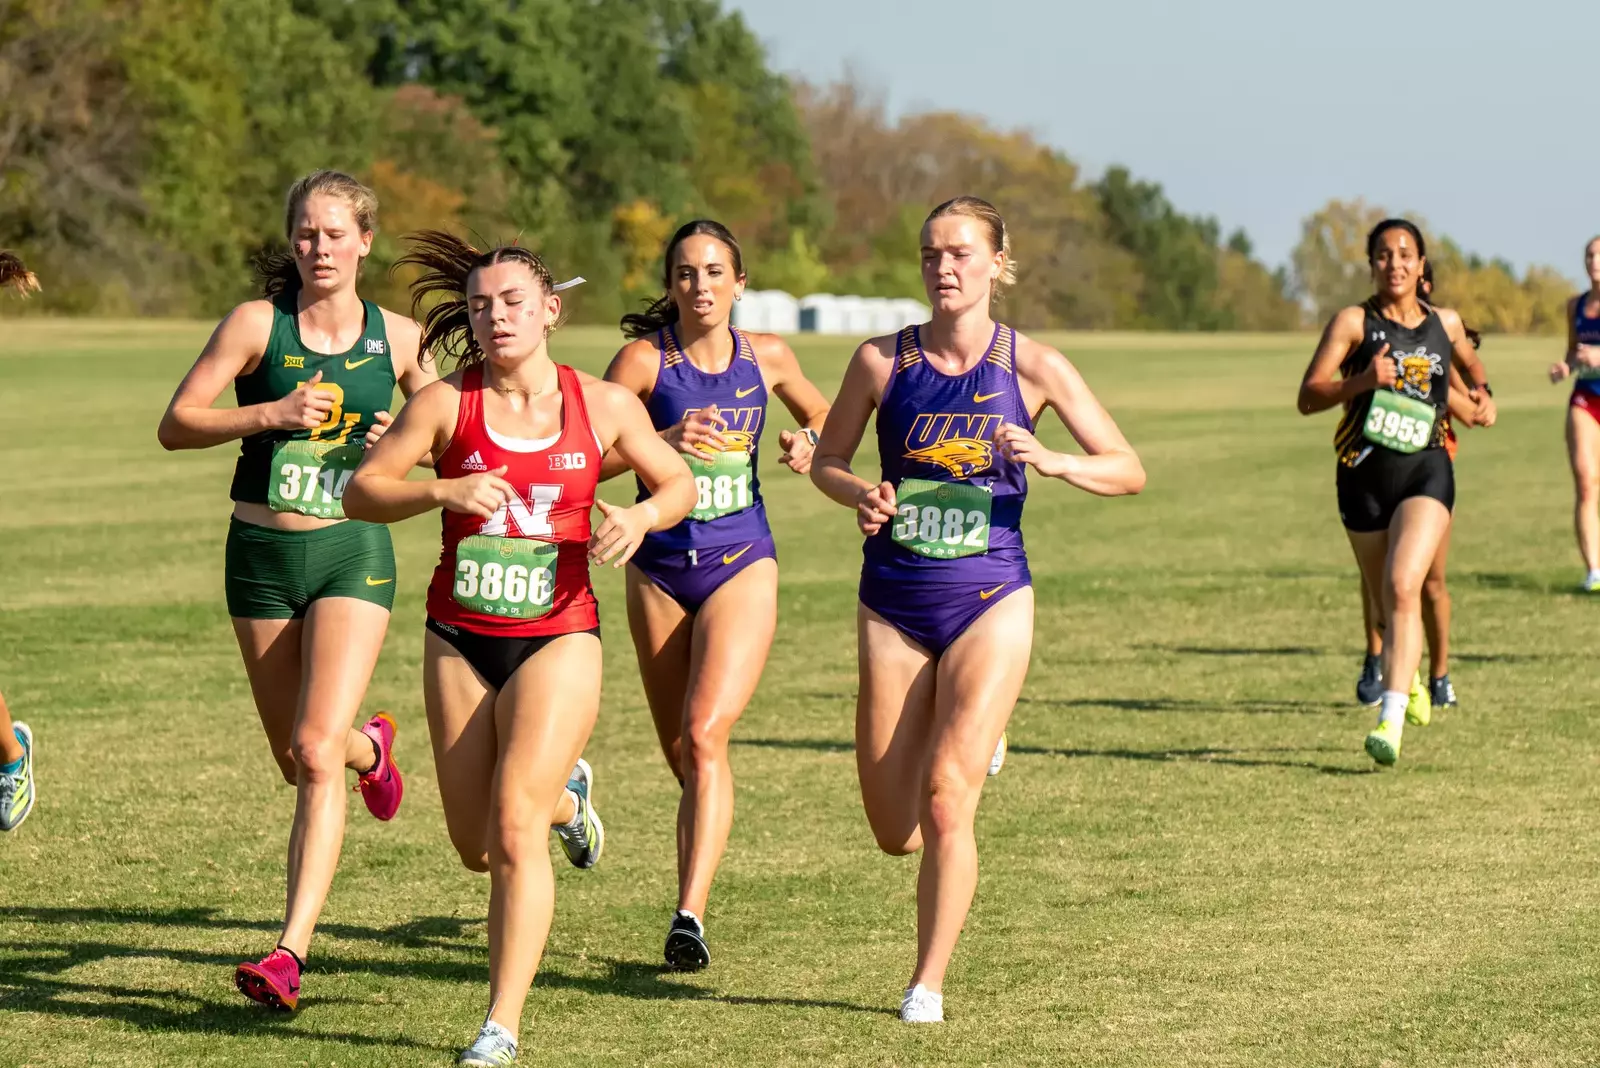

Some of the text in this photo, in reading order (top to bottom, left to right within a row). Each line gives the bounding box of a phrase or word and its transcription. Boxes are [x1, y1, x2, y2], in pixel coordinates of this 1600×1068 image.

[905, 414, 1004, 452] UNI
[1367, 406, 1430, 447] 3953
[461, 462, 488, 471] adidas
[479, 483, 564, 539] N
[694, 474, 748, 510] 881
[896, 503, 987, 547] 3882
[456, 559, 553, 606] 3866
